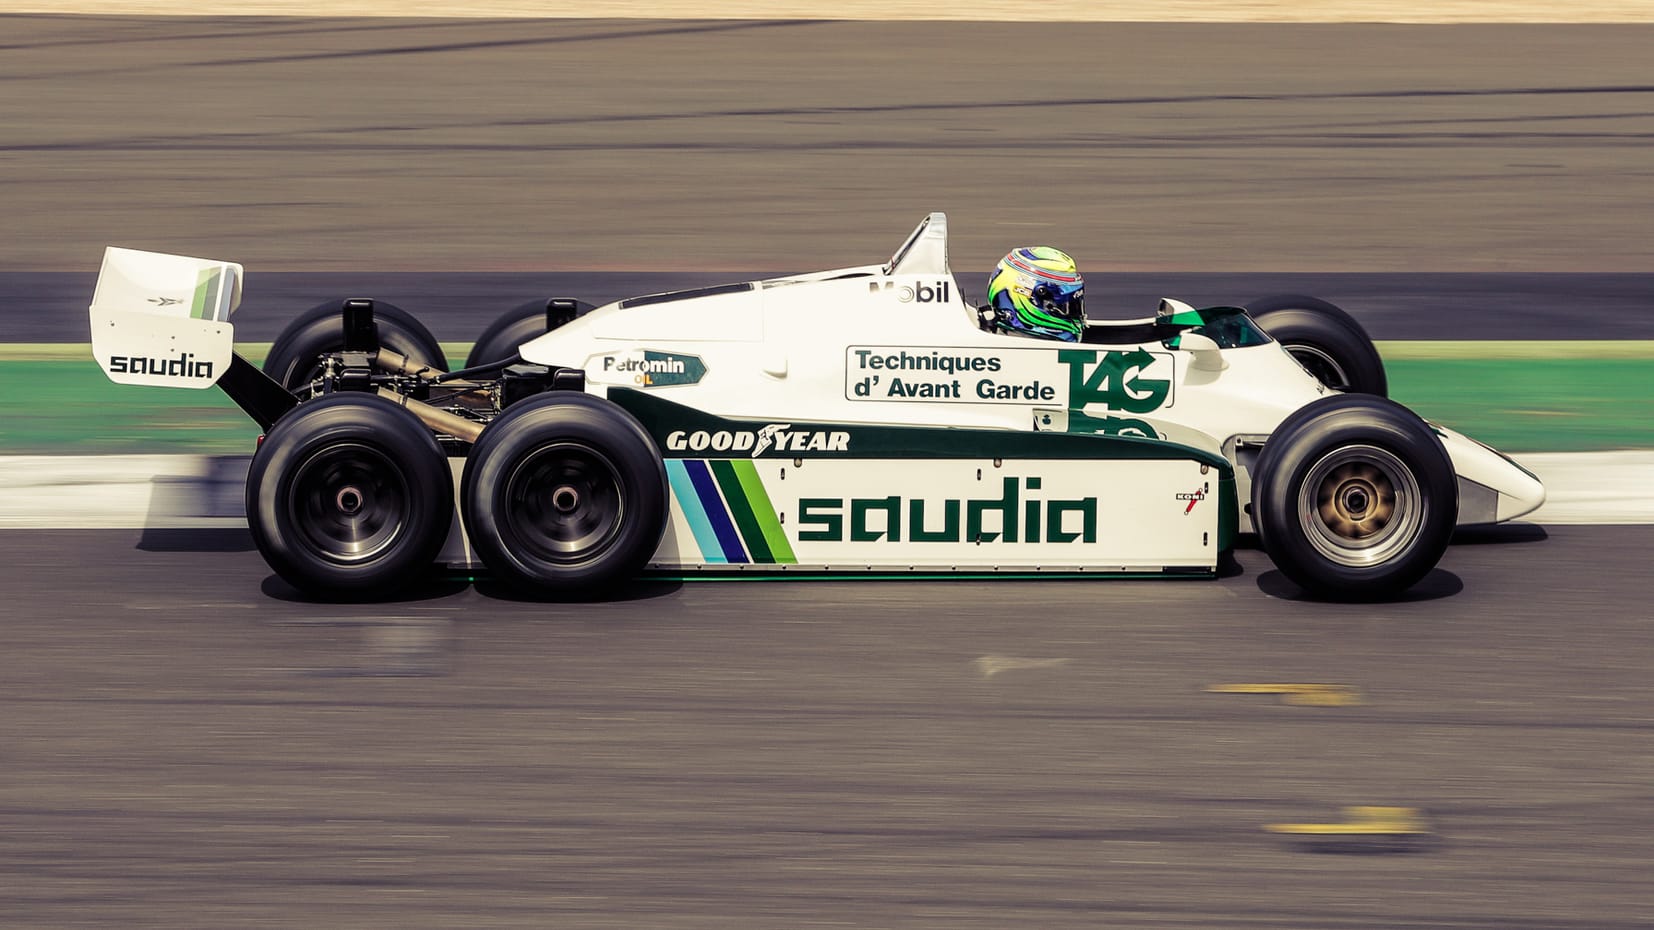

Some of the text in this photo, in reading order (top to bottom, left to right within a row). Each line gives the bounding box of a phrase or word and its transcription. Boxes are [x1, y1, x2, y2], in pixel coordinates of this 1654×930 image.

[110, 352, 213, 379] saudia
[603, 356, 685, 374] Petromin
[854, 350, 1001, 374] Techniques
[634, 374, 654, 385] OIL
[887, 377, 961, 399] Avant
[975, 379, 1056, 401] Garde
[1058, 346, 1171, 414] TAG
[798, 476, 1097, 544] saudia
